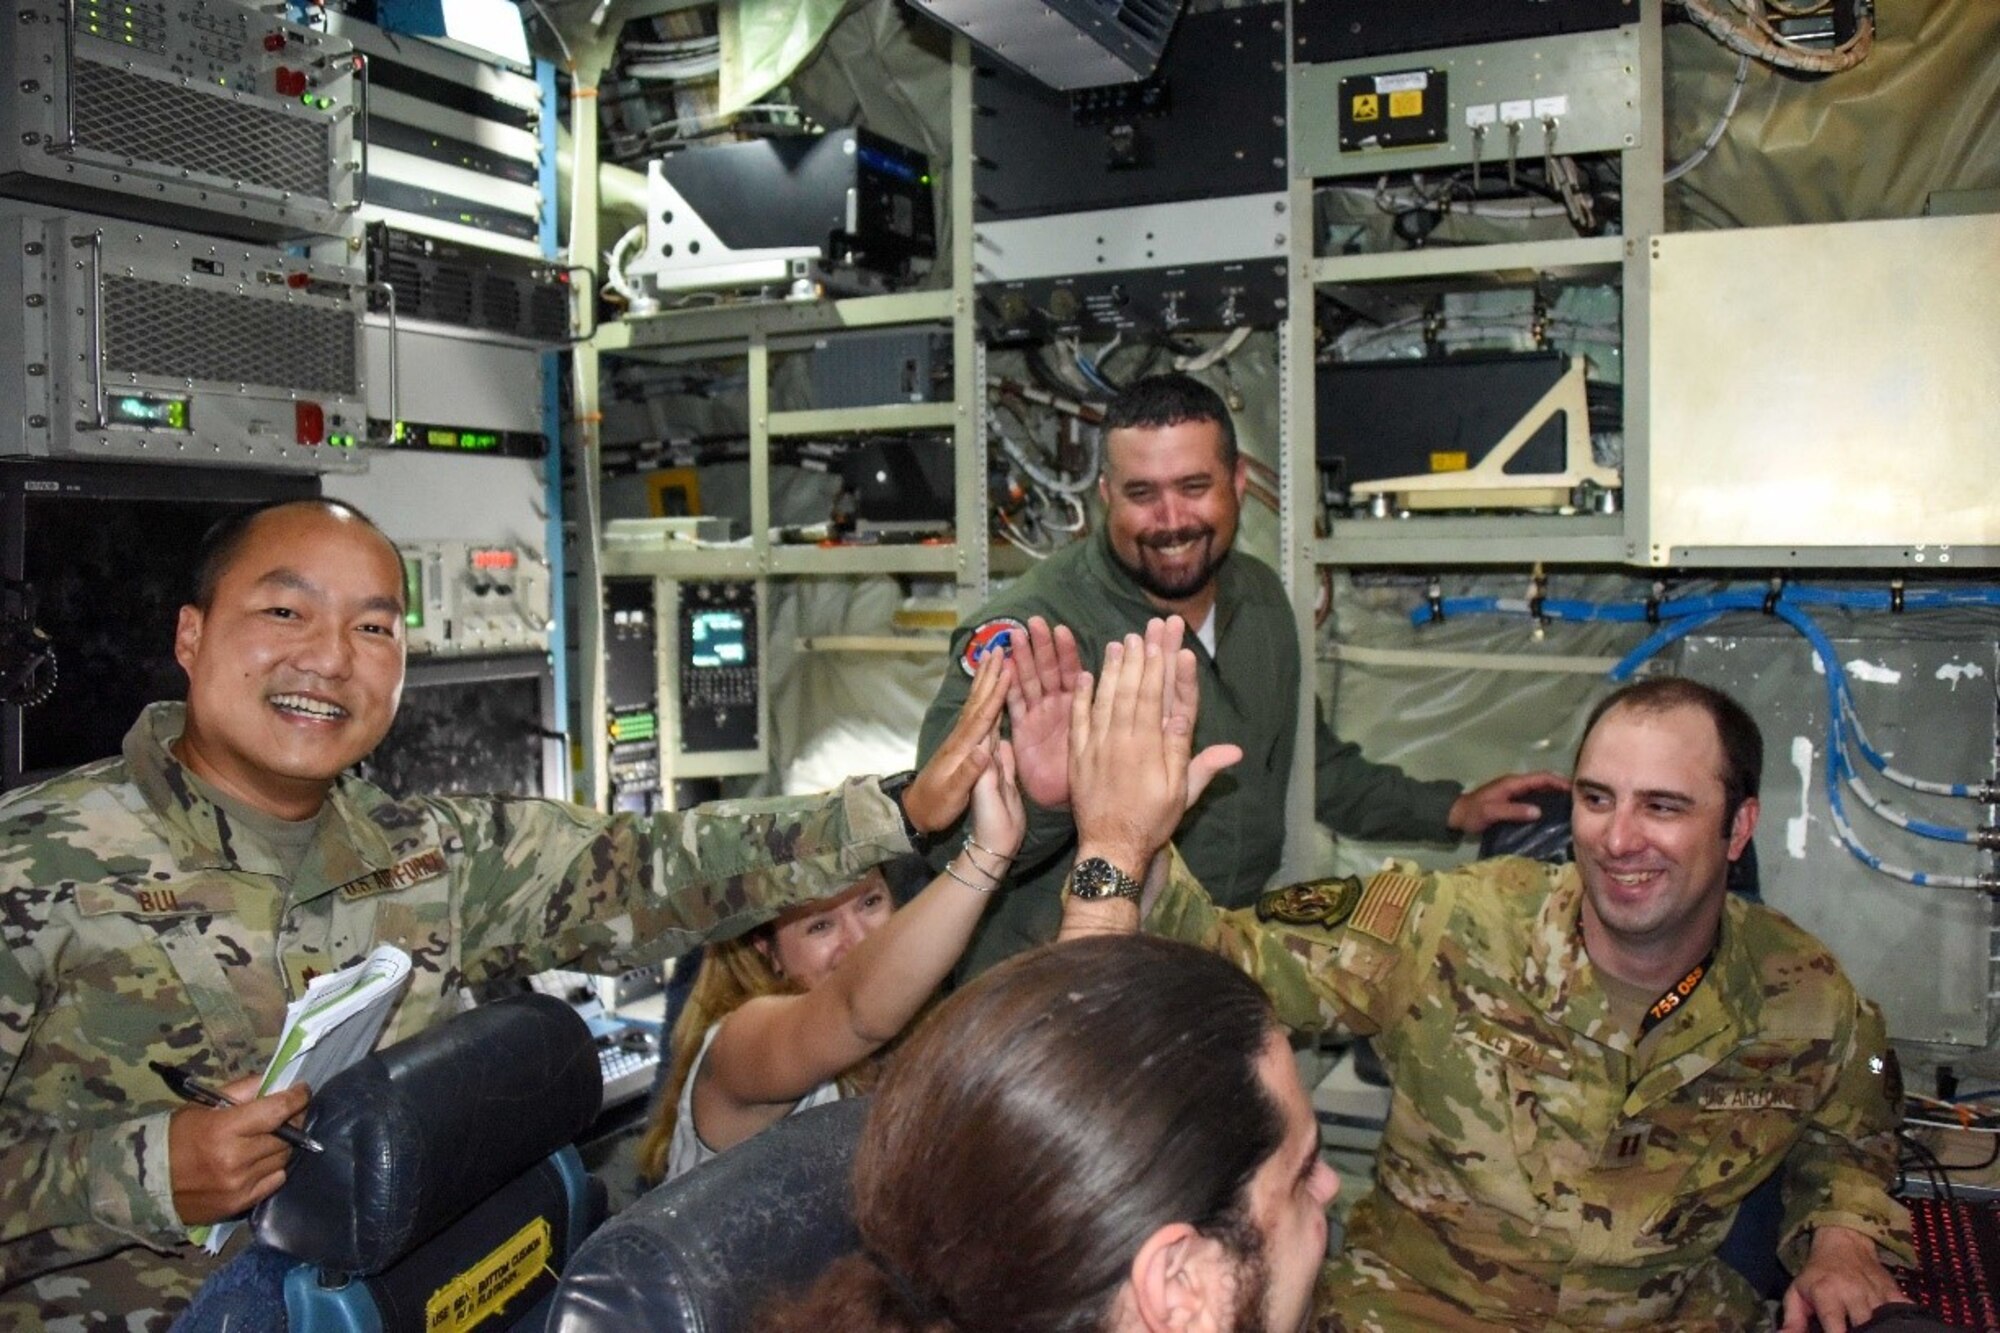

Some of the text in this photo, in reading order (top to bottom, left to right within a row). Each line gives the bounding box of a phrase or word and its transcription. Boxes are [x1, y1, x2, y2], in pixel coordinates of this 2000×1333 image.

[1650, 966, 1703, 1019] 755 OSS
[431, 1305, 450, 1328] USE
[477, 1260, 510, 1295] BOTTOM
[510, 1235, 542, 1268] CUSHION
